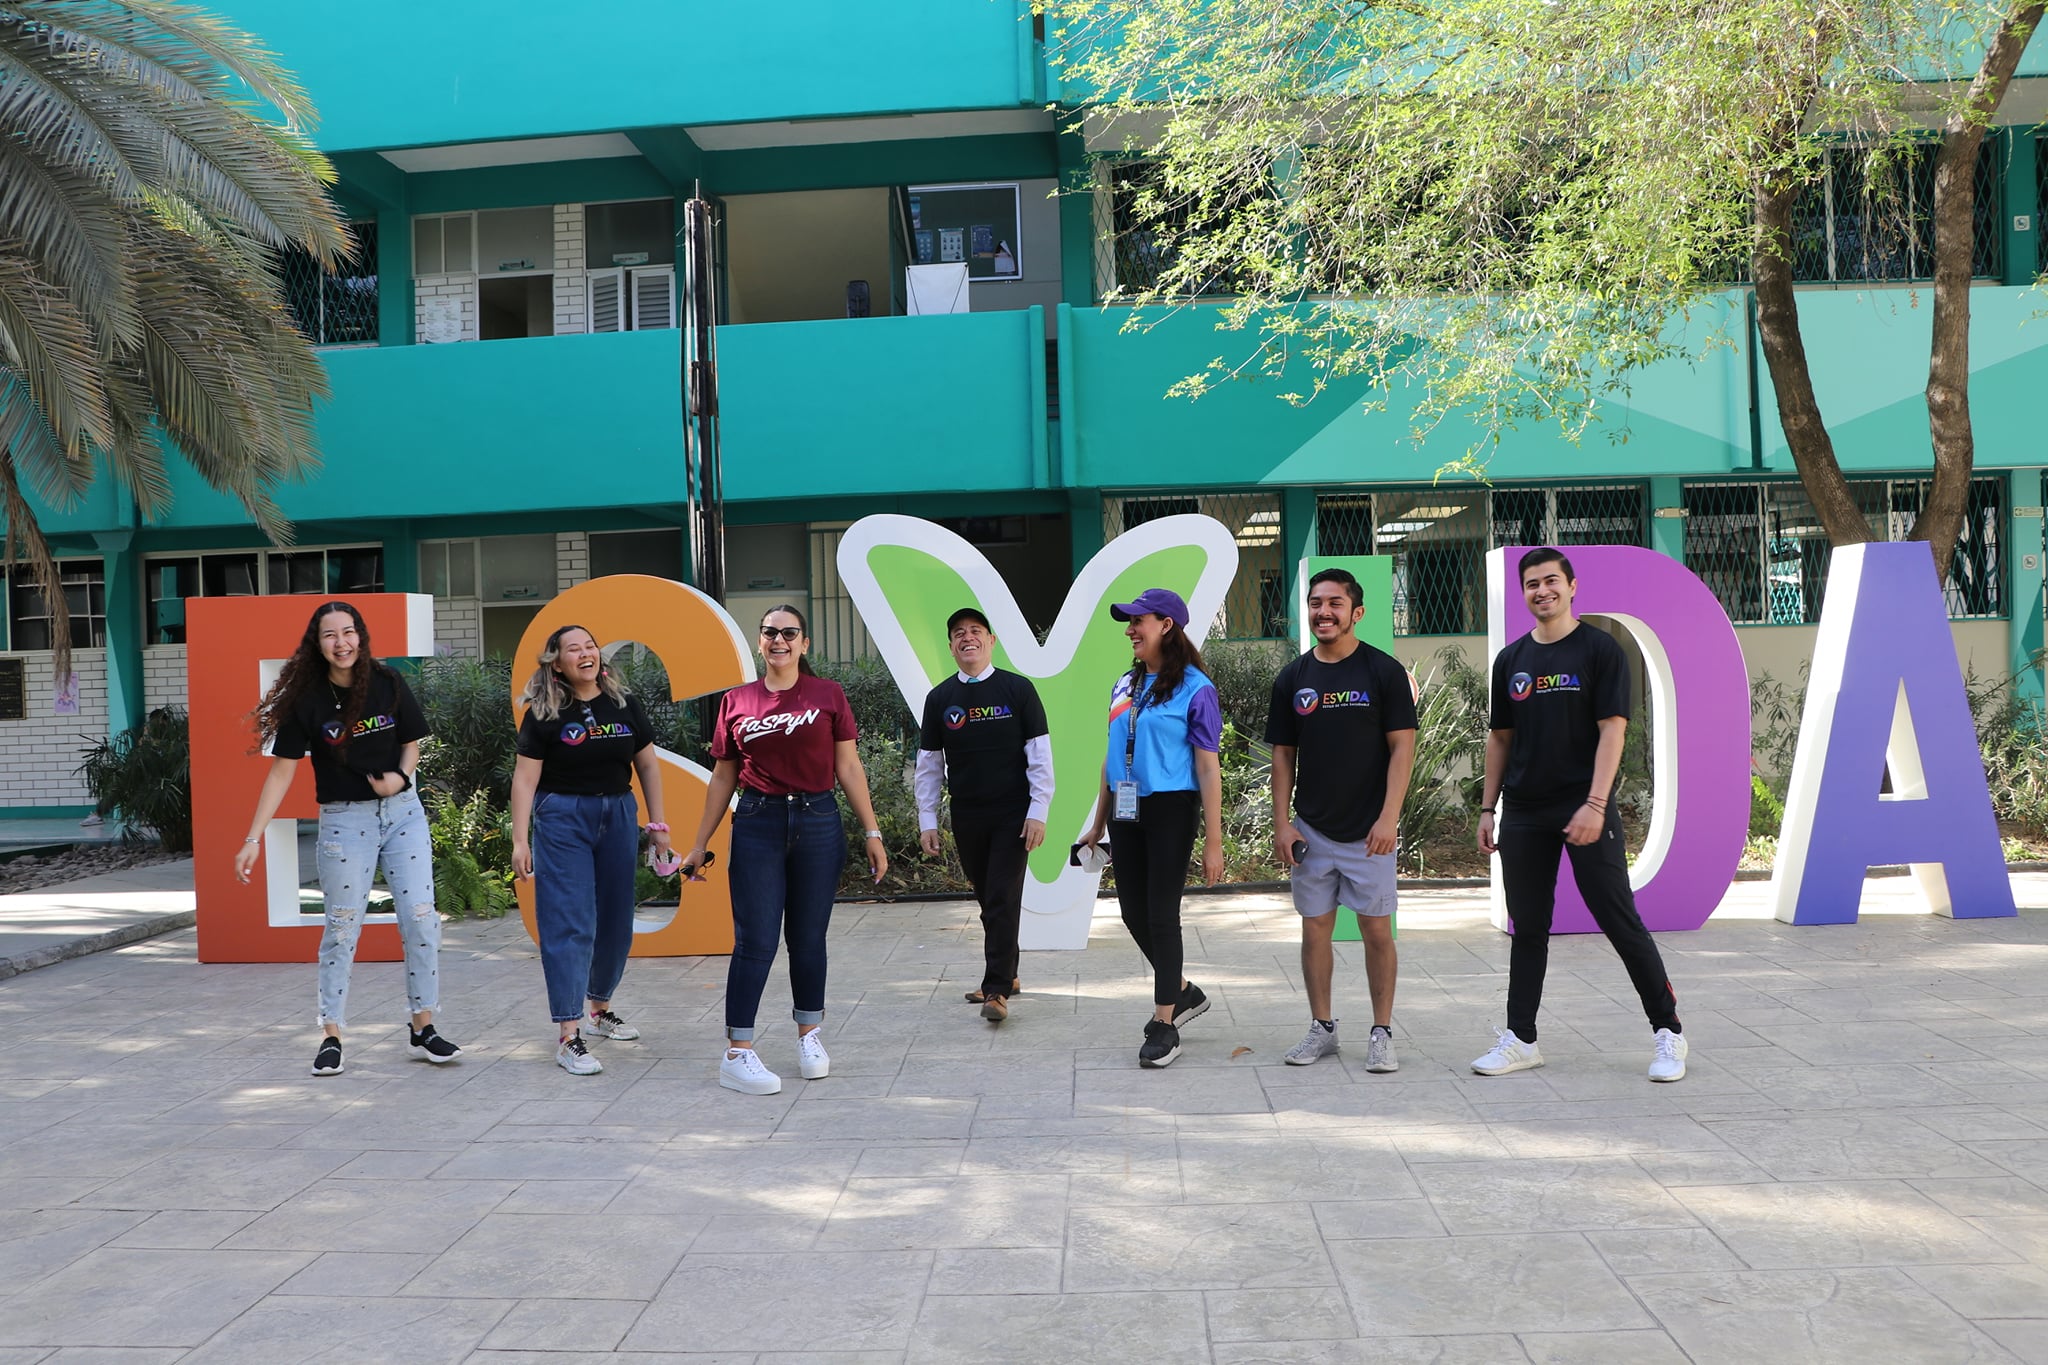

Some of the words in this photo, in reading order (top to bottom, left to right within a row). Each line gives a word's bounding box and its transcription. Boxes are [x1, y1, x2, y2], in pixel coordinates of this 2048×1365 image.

[1536, 674, 1580, 689] ESVIDA
[1323, 691, 1370, 704] ESVIDA
[969, 705, 1011, 718] ESVIDA
[589, 723, 631, 735] ESVIDA
[186, 513, 2016, 964] ESVDA
